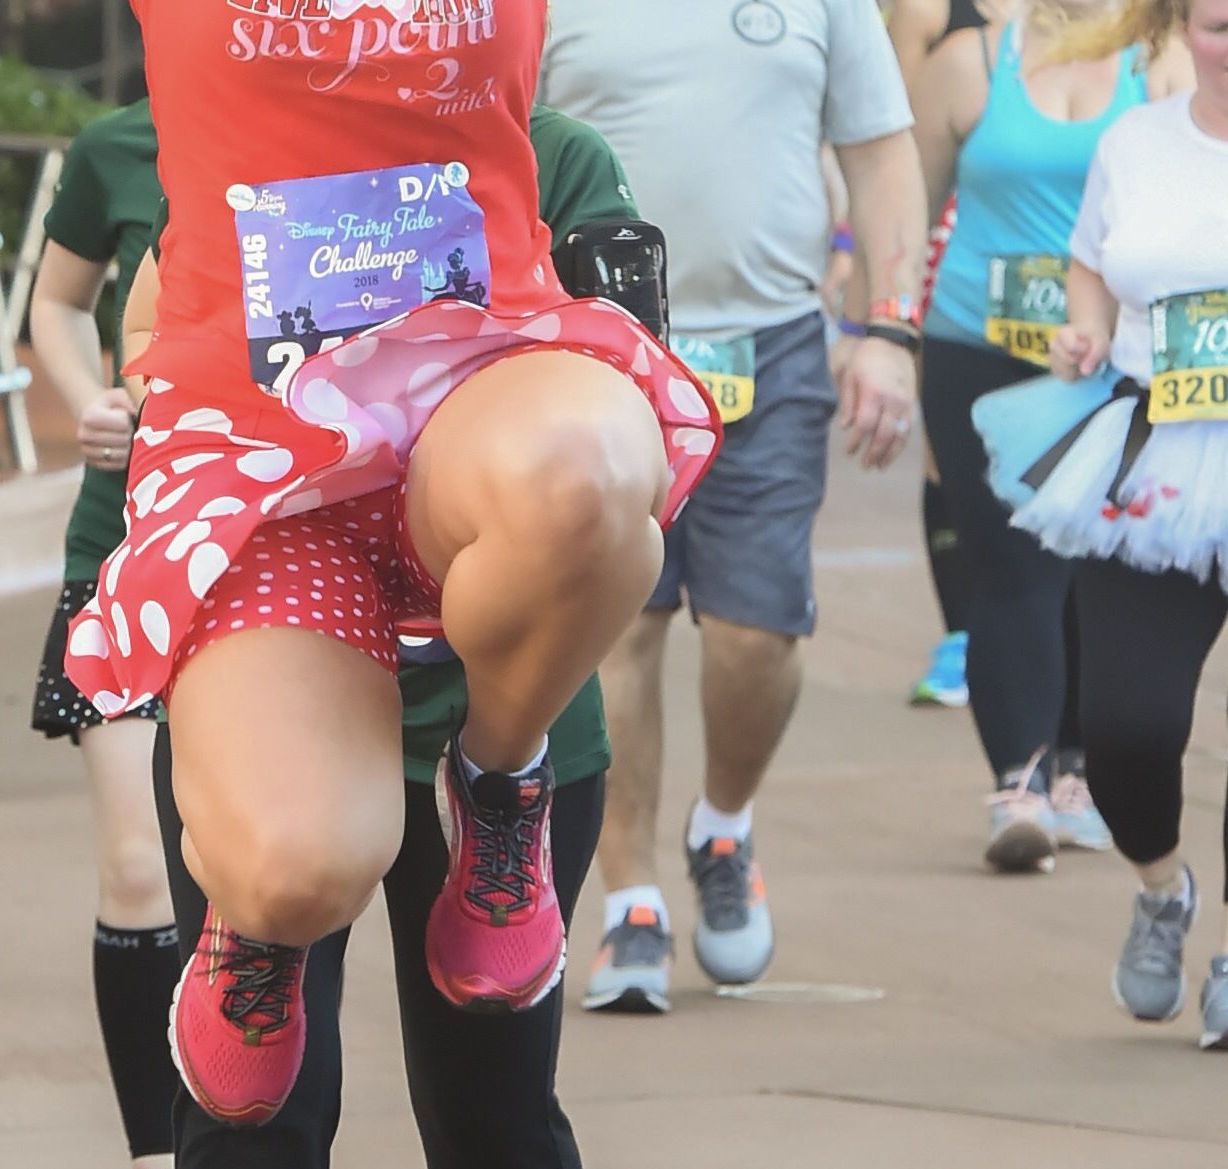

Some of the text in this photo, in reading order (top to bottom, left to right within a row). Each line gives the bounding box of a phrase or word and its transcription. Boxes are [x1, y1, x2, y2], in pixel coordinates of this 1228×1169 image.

[226, 5, 332, 62] six
[286, 205, 435, 248] Disney Fairy Tale
[242, 234, 273, 319] 24146
[309, 241, 418, 280] Challenge
[354, 274, 379, 288] 2018
